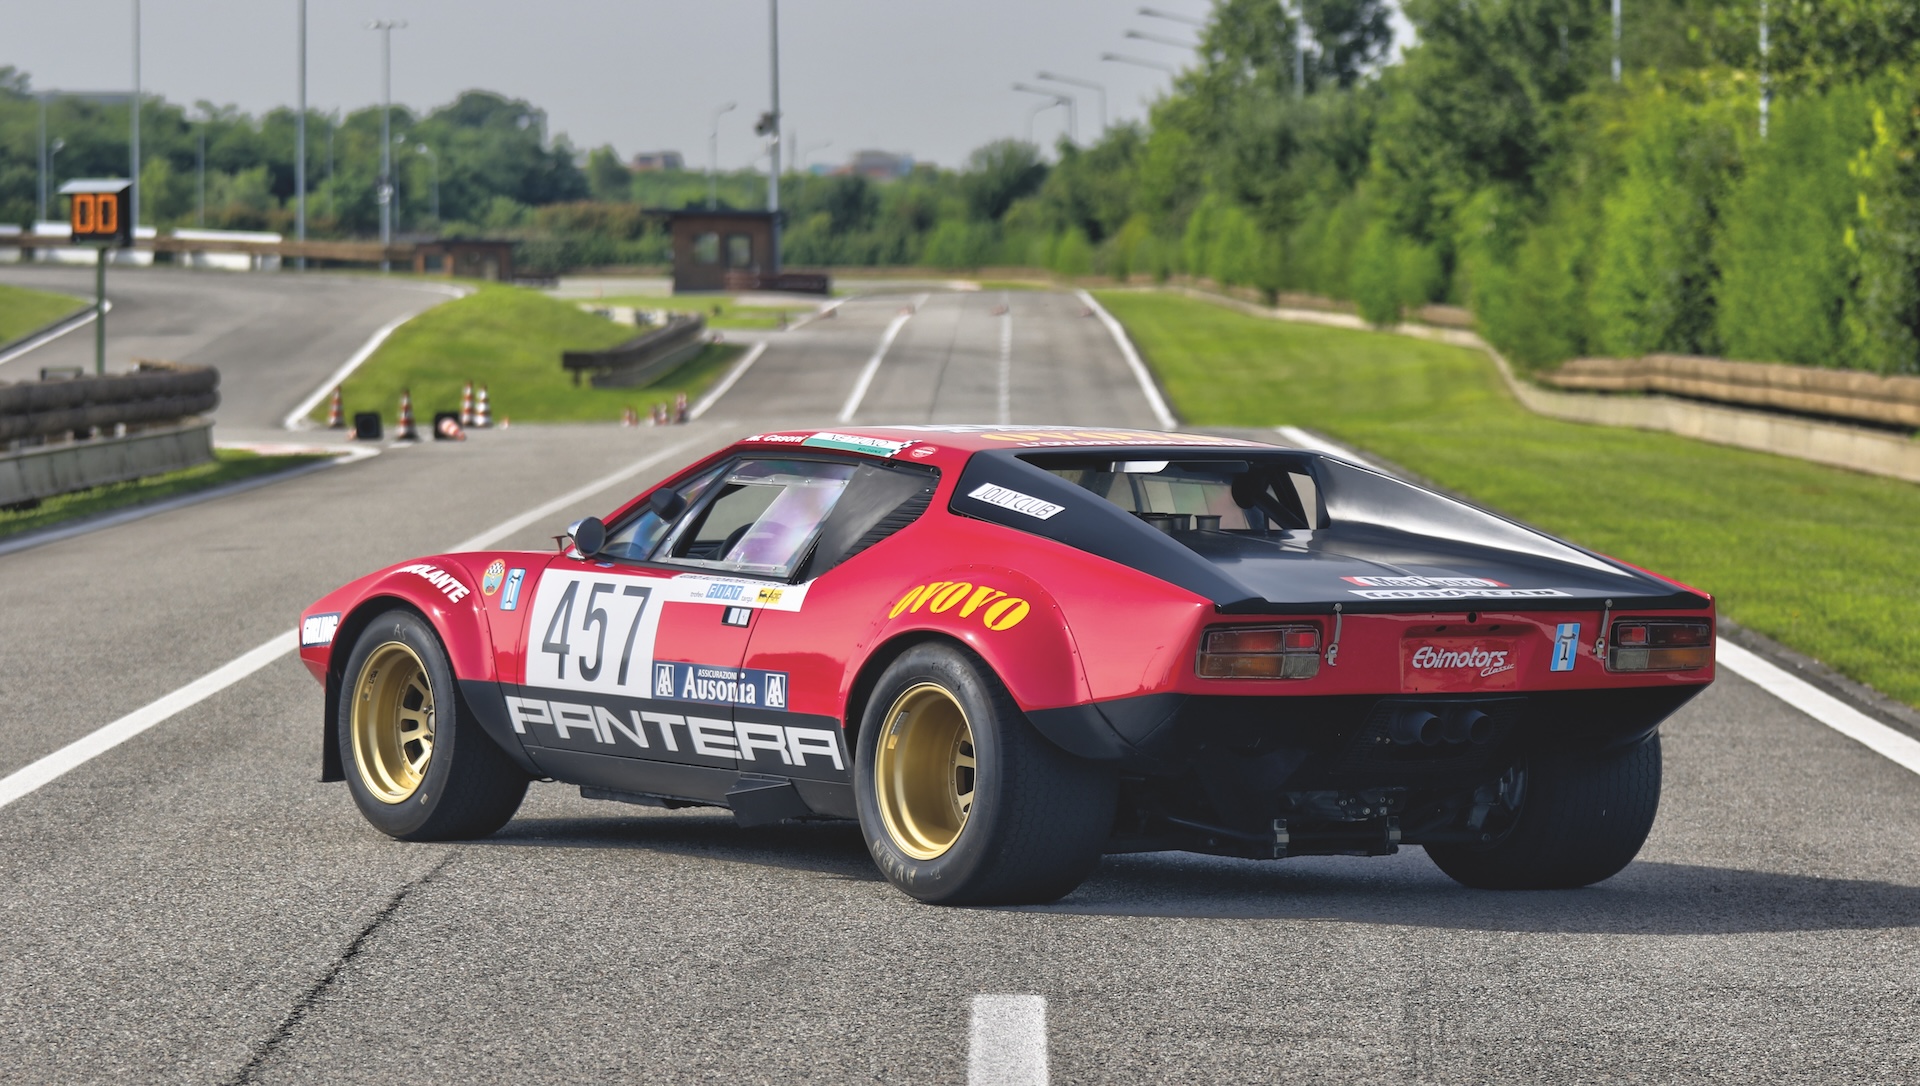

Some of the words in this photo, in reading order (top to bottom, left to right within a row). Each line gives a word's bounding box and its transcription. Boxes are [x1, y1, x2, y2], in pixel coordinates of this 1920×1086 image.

[73, 193, 118, 234] 00
[764, 434, 808, 443] Casoni
[1363, 576, 1492, 587] Marlboro
[707, 584, 743, 600] FIAT
[1365, 589, 1556, 598] GOODYEAR
[889, 581, 1030, 631] OVOVO
[541, 580, 652, 686] 457
[1412, 646, 1508, 669] Ebimotors
[698, 669, 738, 679] ASSICURAZIONI
[1480, 664, 1515, 677] Classic
[682, 666, 756, 704] Ausonia
[505, 696, 844, 770] PANTERA
